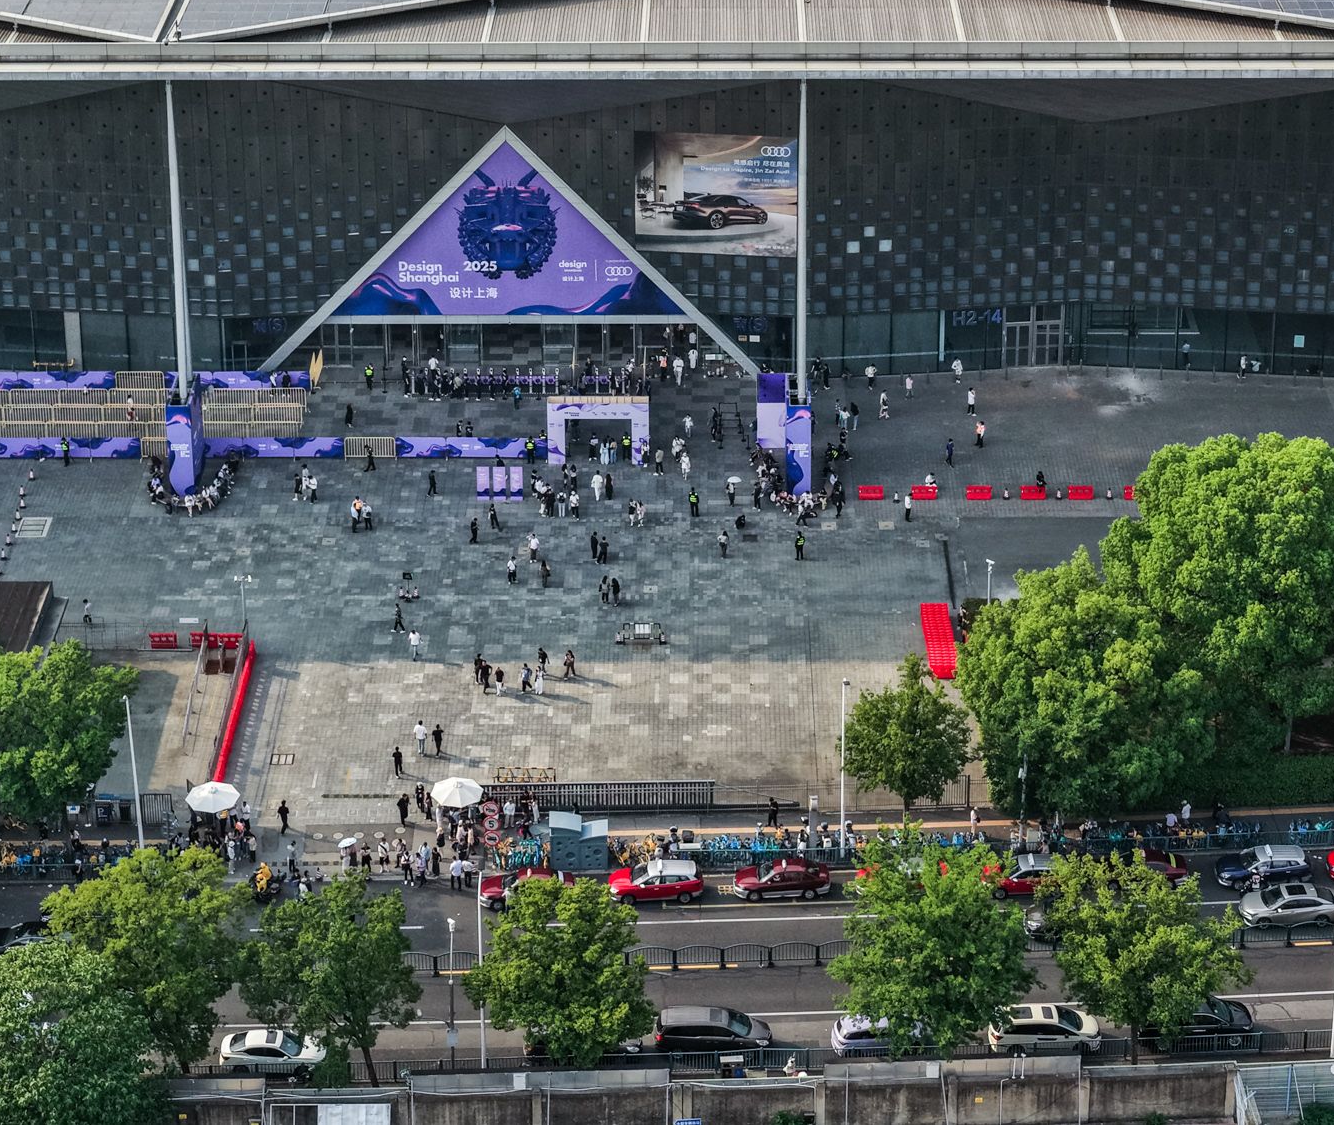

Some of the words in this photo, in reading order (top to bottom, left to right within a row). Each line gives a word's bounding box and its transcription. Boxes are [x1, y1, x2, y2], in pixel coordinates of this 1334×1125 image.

[398, 260, 442, 274] Design
[463, 260, 498, 272] 2025
[559, 260, 587, 269] design
[399, 272, 459, 285] Shanghai
[449, 287, 498, 299] 设计上海
[952, 308, 1003, 326] H2-14
[488, 820, 495, 828] 5
